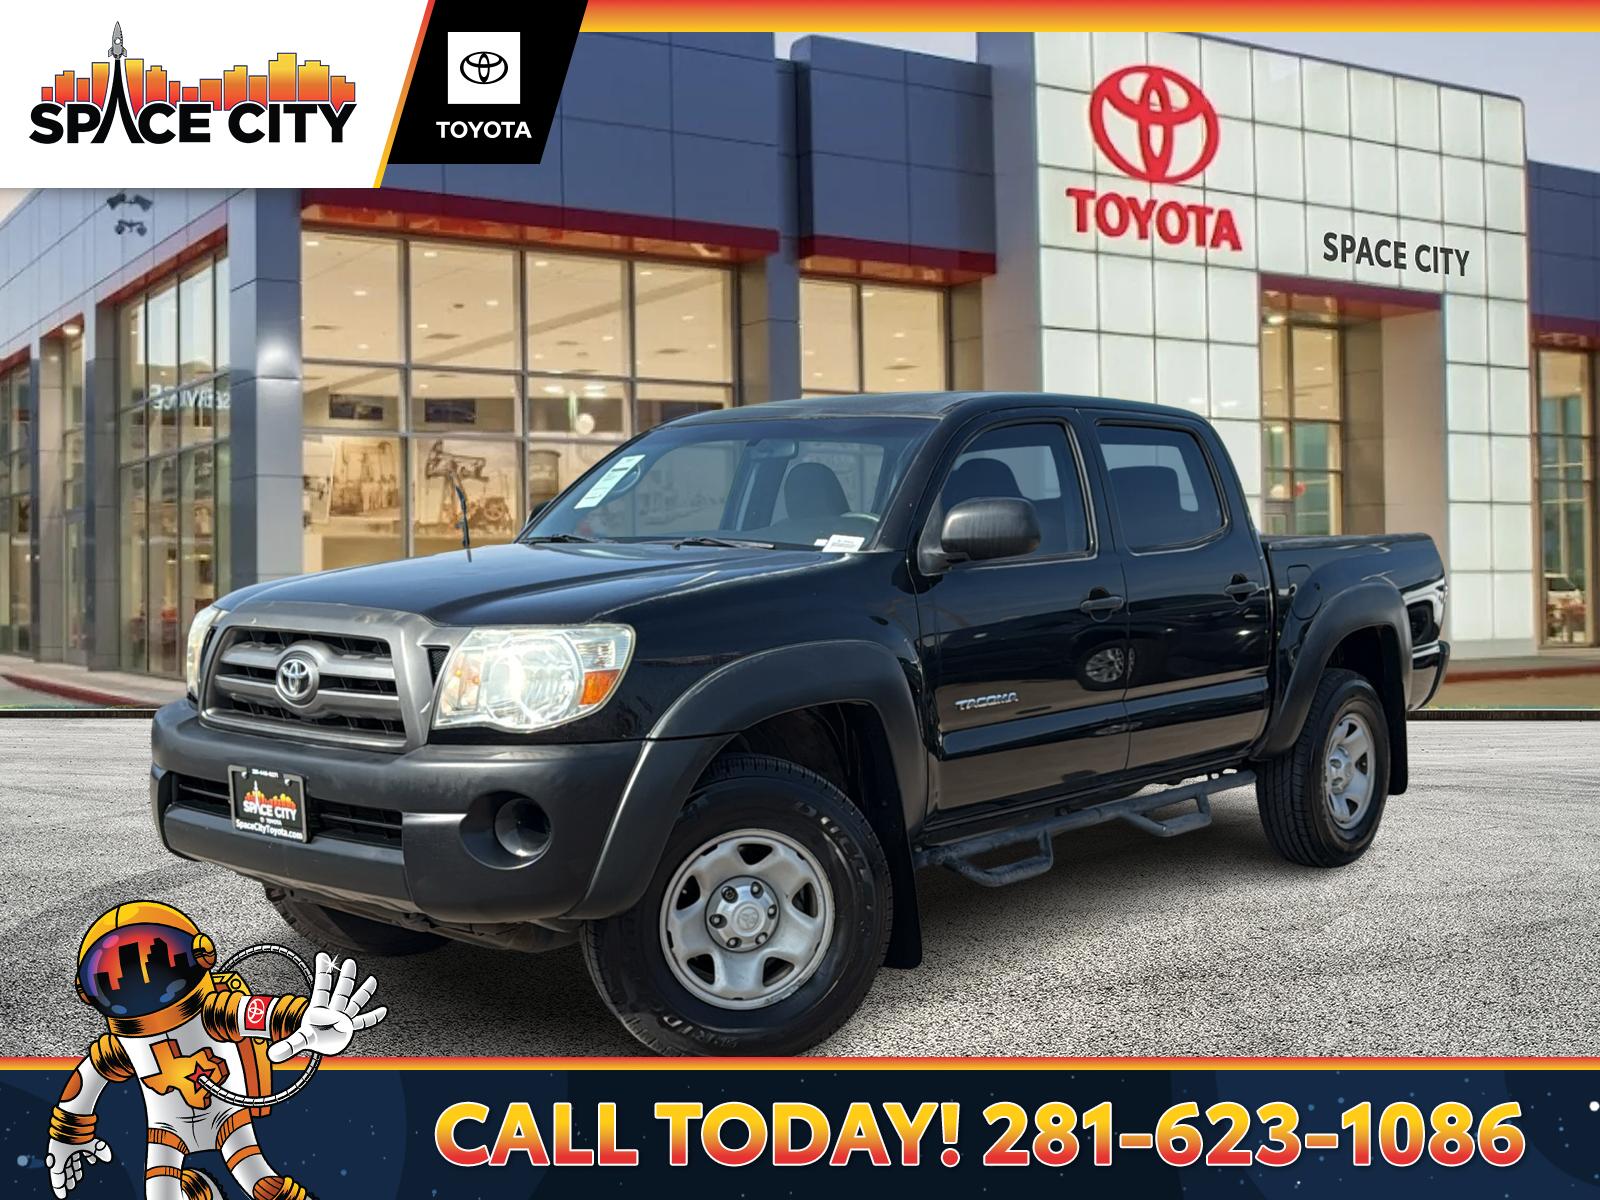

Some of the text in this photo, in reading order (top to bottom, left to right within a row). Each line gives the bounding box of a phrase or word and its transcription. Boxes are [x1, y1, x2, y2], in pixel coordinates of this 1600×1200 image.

[1066, 188, 1242, 251] TOYOTA
[1323, 232, 1470, 277] SPACE CITY
[955, 692, 1019, 711] TACOMA
[243, 790, 297, 821] SPACE CITY
[235, 818, 303, 840] SpaceCityToyota.com
